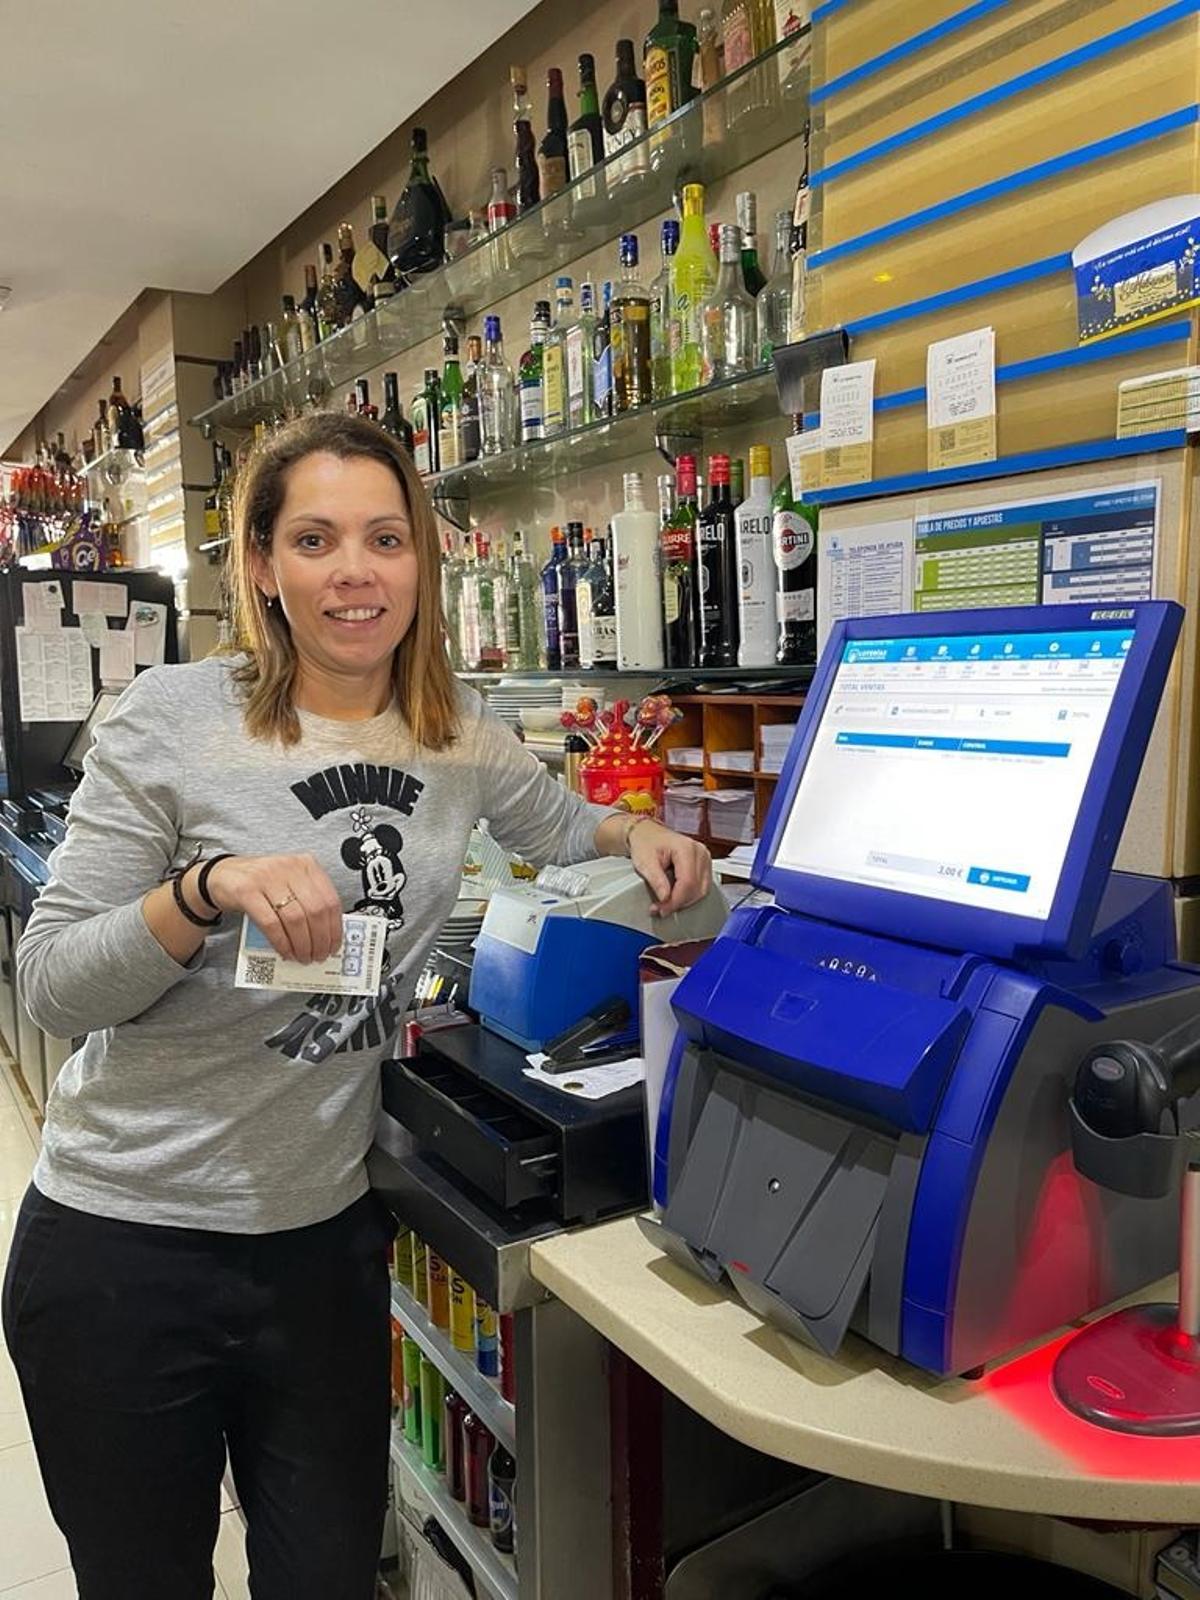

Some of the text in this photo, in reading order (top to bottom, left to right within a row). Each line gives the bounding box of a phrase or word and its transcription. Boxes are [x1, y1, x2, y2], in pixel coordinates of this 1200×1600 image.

[935, 520, 943, 532] DE
[943, 517, 967, 531] PRECIOS
[972, 512, 1004, 528] APUESTAS
[289, 763, 425, 820] MINNIE
